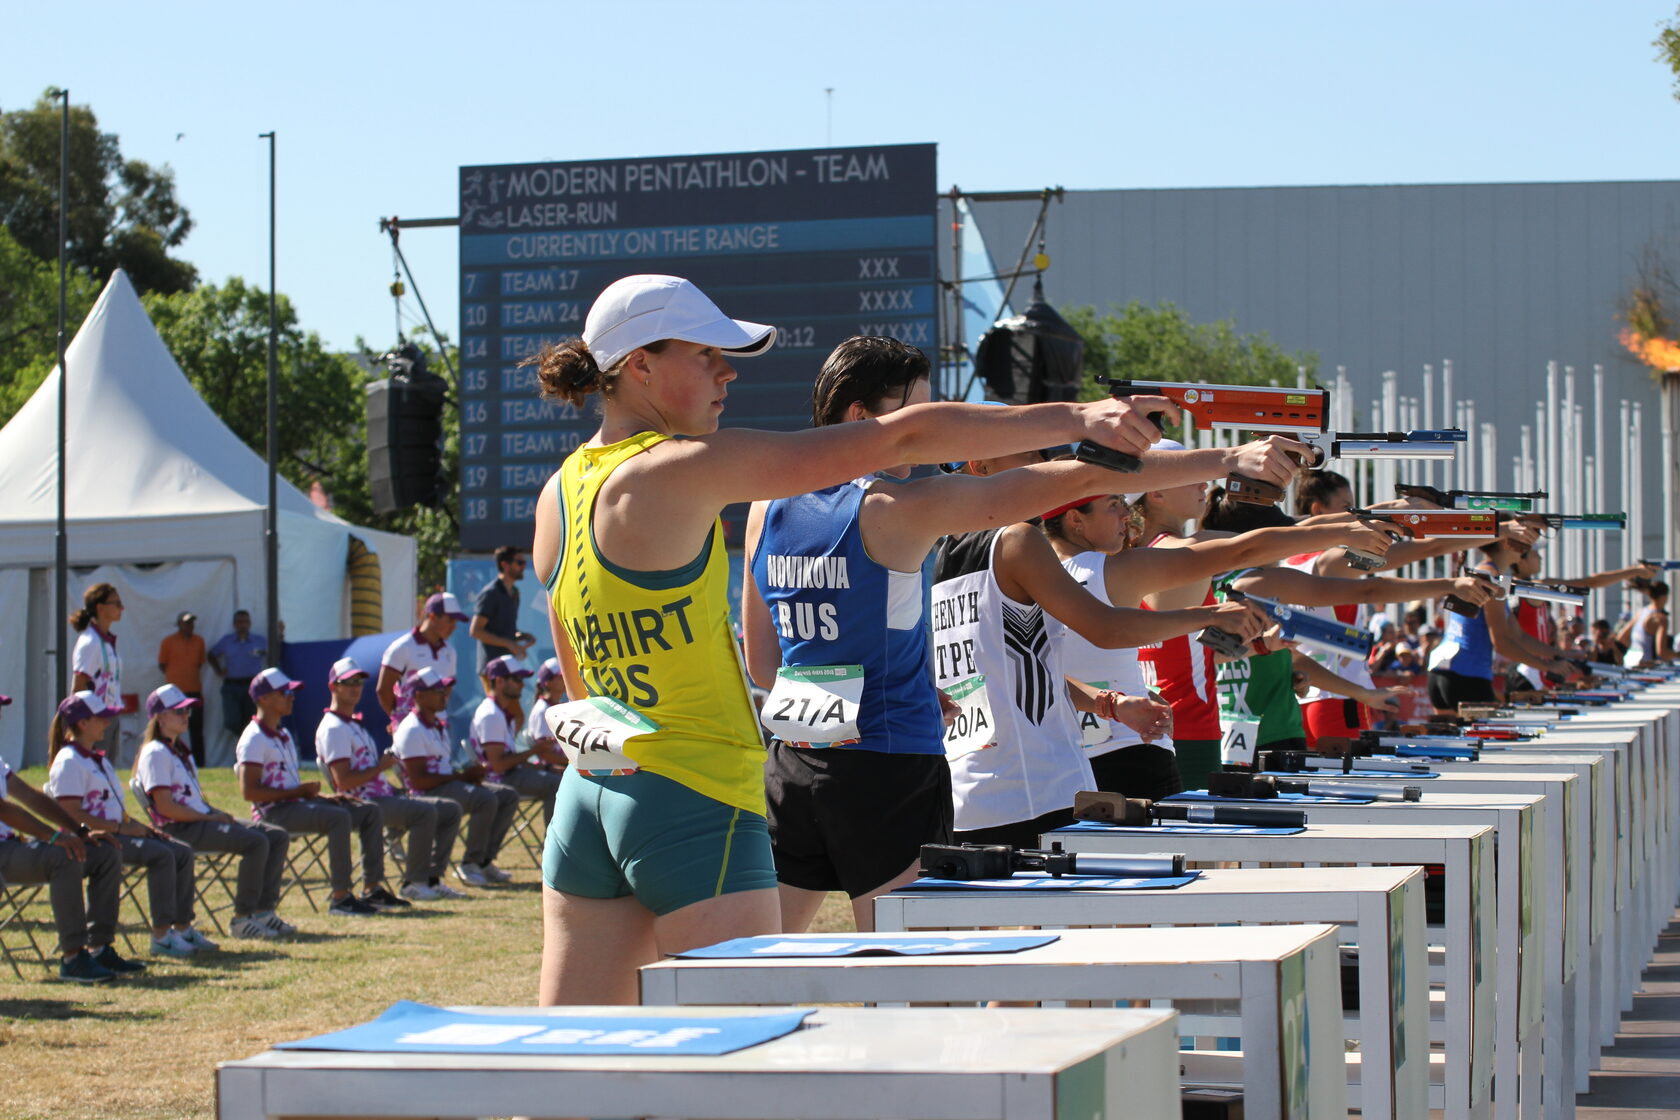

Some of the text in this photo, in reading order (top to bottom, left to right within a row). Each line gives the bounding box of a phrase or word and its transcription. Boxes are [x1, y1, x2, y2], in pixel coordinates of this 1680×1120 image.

[506, 165, 617, 198] MODERN
[625, 157, 788, 192] PENTATHLON
[813, 154, 890, 183] TEAM
[506, 202, 617, 228] LASER-RUN
[506, 225, 779, 259] CURRENTLY ON THE RANGE
[465, 258, 900, 294] 7 TEAM 17 XXX
[466, 290, 913, 326] 10 TEAM 24 XXXX
[466, 338, 487, 358] 14
[467, 369, 487, 391] 15
[466, 402, 487, 422] 16
[502, 400, 555, 421] TEAM
[467, 432, 580, 455] 17 TEAM 10
[467, 467, 488, 488] 19
[467, 499, 488, 519] 18
[767, 554, 850, 589] NOVIKOVA
[564, 595, 694, 663] WHIRT
[777, 600, 839, 641] RUS
[936, 639, 977, 680] TPE
[772, 694, 845, 726] 21/A
[948, 706, 988, 742] 20/A
